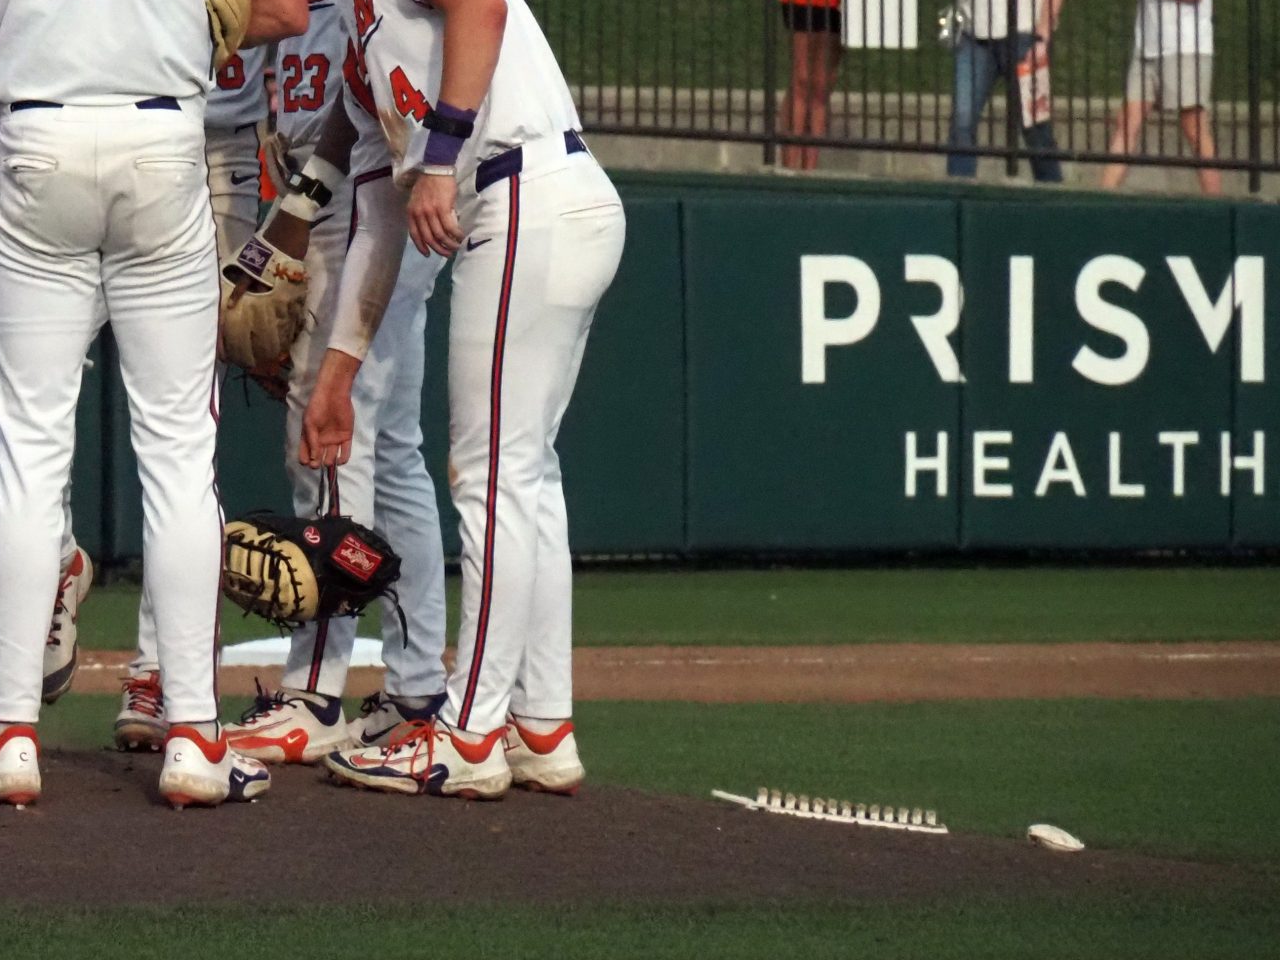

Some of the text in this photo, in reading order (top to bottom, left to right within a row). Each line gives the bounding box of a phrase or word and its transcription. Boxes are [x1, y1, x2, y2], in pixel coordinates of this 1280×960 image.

[282, 53, 330, 113] 23
[800, 254, 1265, 385] PRISM
[905, 431, 1265, 497] HEALTH
